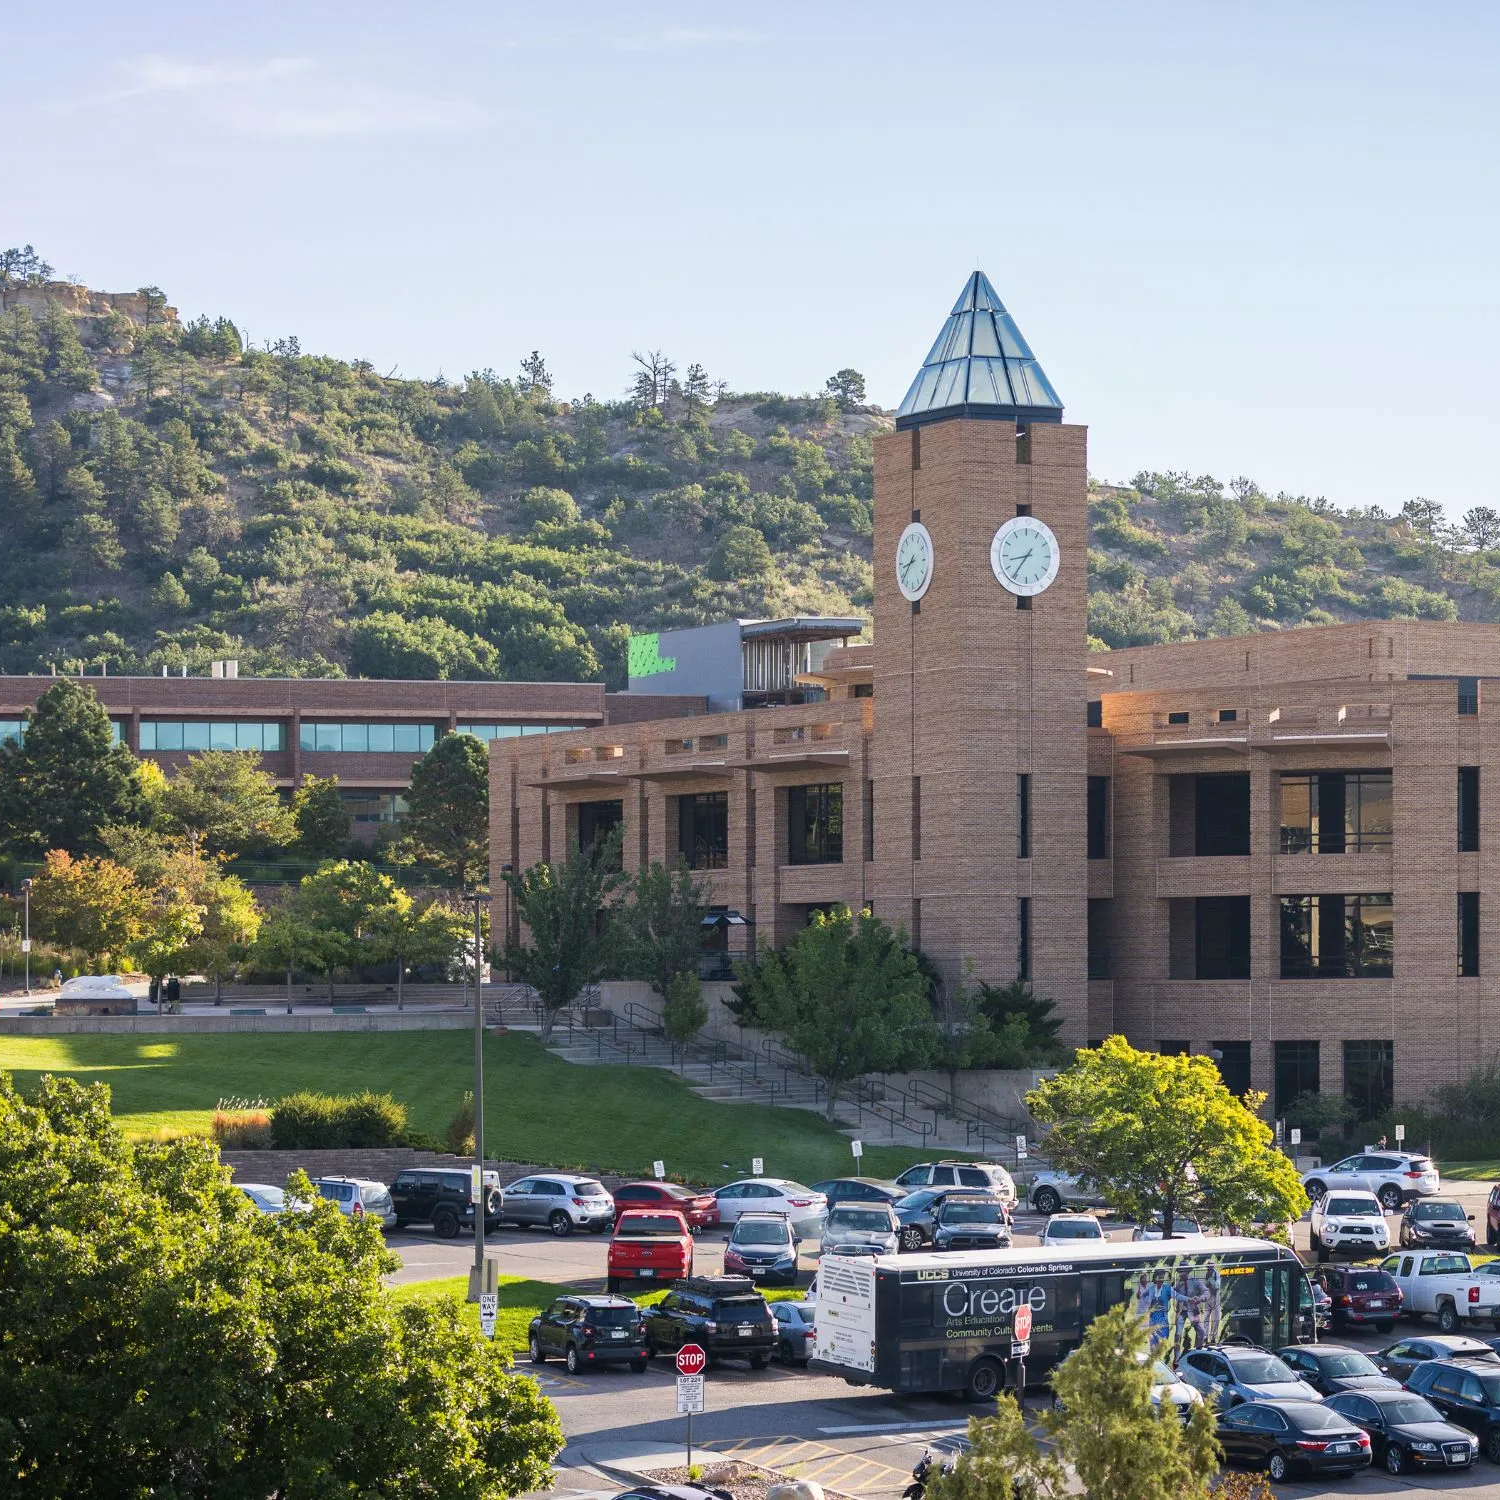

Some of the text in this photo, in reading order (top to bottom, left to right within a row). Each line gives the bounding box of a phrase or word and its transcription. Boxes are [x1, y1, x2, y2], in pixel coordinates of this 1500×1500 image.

[917, 1264, 1073, 1281] UCCS University of Colorado Colorado Springs
[944, 1282, 1046, 1316] Create
[946, 1315, 1005, 1326] Arts Education
[1015, 1316, 1031, 1331] STOP
[946, 1329, 992, 1338] Community
[1031, 1324, 1053, 1333] vents
[679, 1353, 703, 1366] STOP
